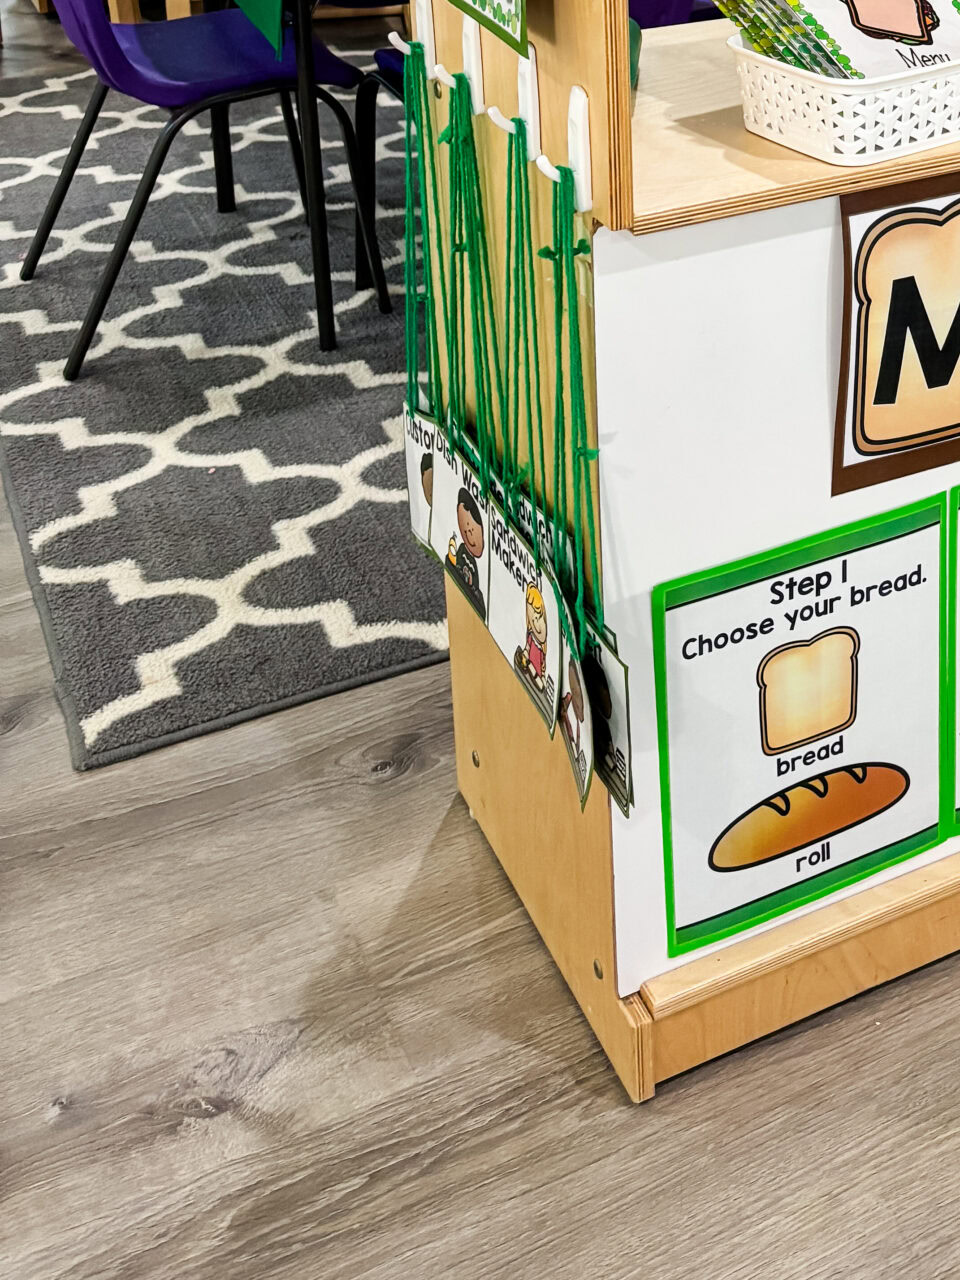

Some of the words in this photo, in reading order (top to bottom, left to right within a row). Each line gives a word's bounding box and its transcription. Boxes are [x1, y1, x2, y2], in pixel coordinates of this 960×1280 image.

[436, 431, 458, 476] Dish
[490, 505, 543, 594] Sandwich
[491, 531, 528, 593] Maker
[769, 568, 832, 606] Step
[841, 559, 848, 584] 1
[681, 617, 775, 660] Choose
[783, 594, 842, 631] your
[849, 564, 928, 607] bread.
[775, 735, 844, 778] bread
[795, 841, 831, 873] roll
